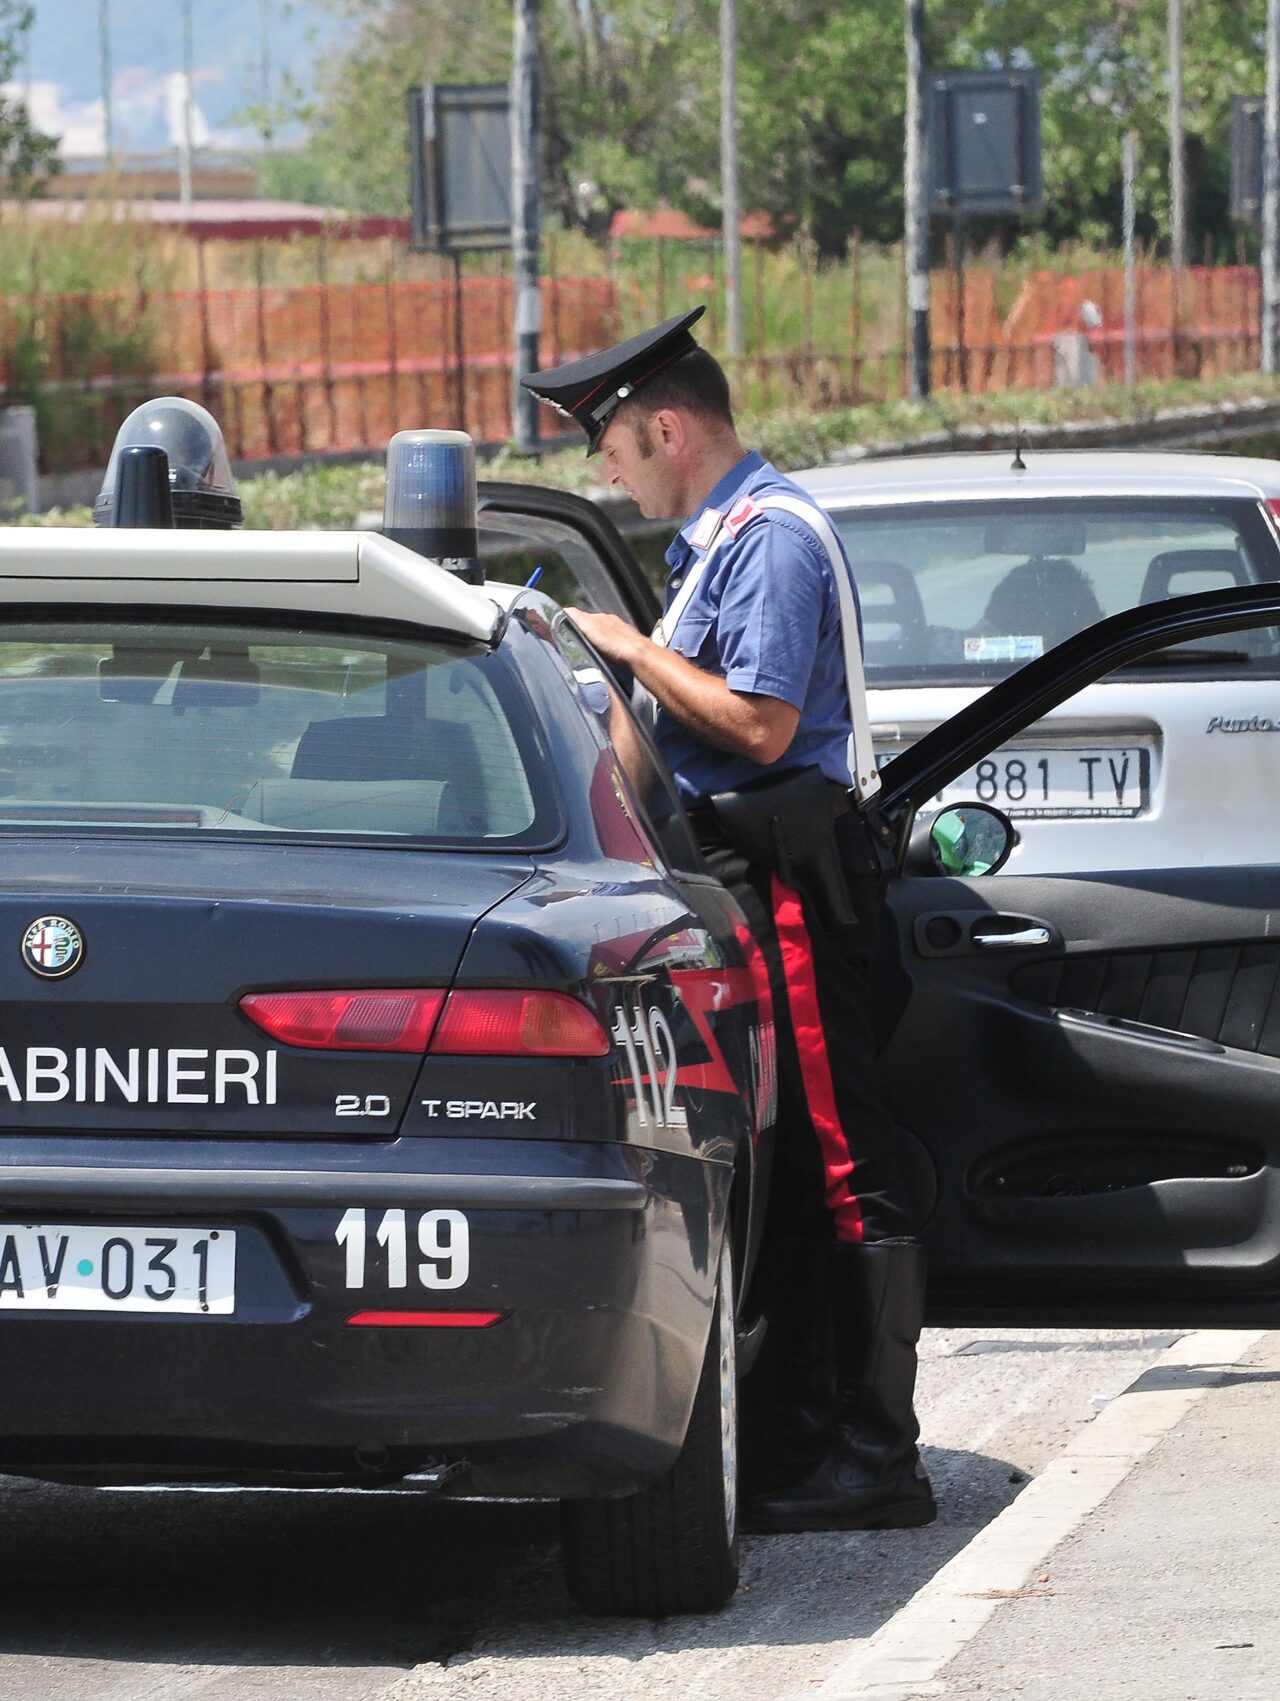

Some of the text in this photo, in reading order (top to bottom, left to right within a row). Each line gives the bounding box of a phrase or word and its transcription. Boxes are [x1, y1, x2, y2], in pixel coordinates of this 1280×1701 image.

[975, 756, 1130, 803] 881 TV
[25, 919, 81, 950] ALFA ROMEO
[610, 1005, 689, 1129] 112
[334, 1094, 392, 1117] 2.0
[446, 1100, 538, 1120] SPARK
[100, 1236, 211, 1303] 031
[334, 1207, 471, 1291] 119
